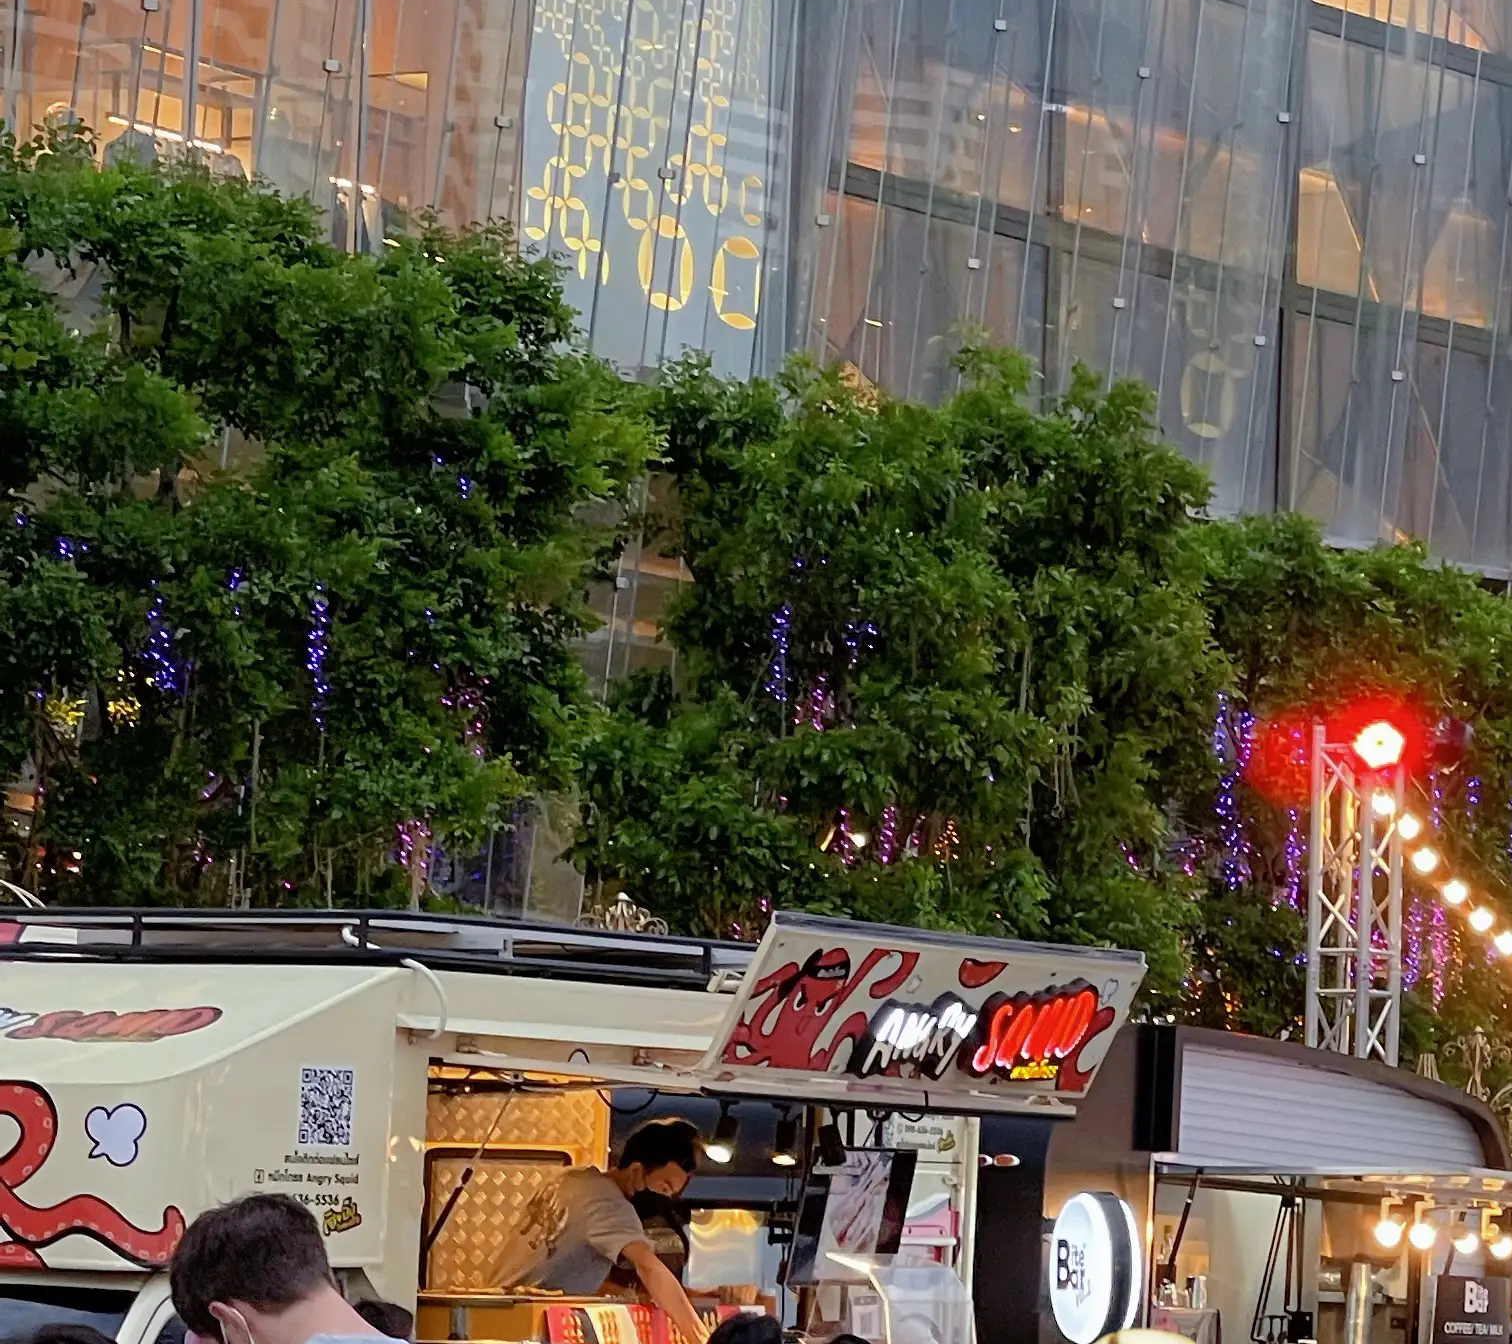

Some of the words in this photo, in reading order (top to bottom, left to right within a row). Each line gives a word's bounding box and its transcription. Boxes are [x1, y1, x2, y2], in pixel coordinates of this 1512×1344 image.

[306, 1173, 332, 1186] Angry
[334, 1173, 359, 1186] Squid
[292, 1194, 340, 1206] 36-5536
